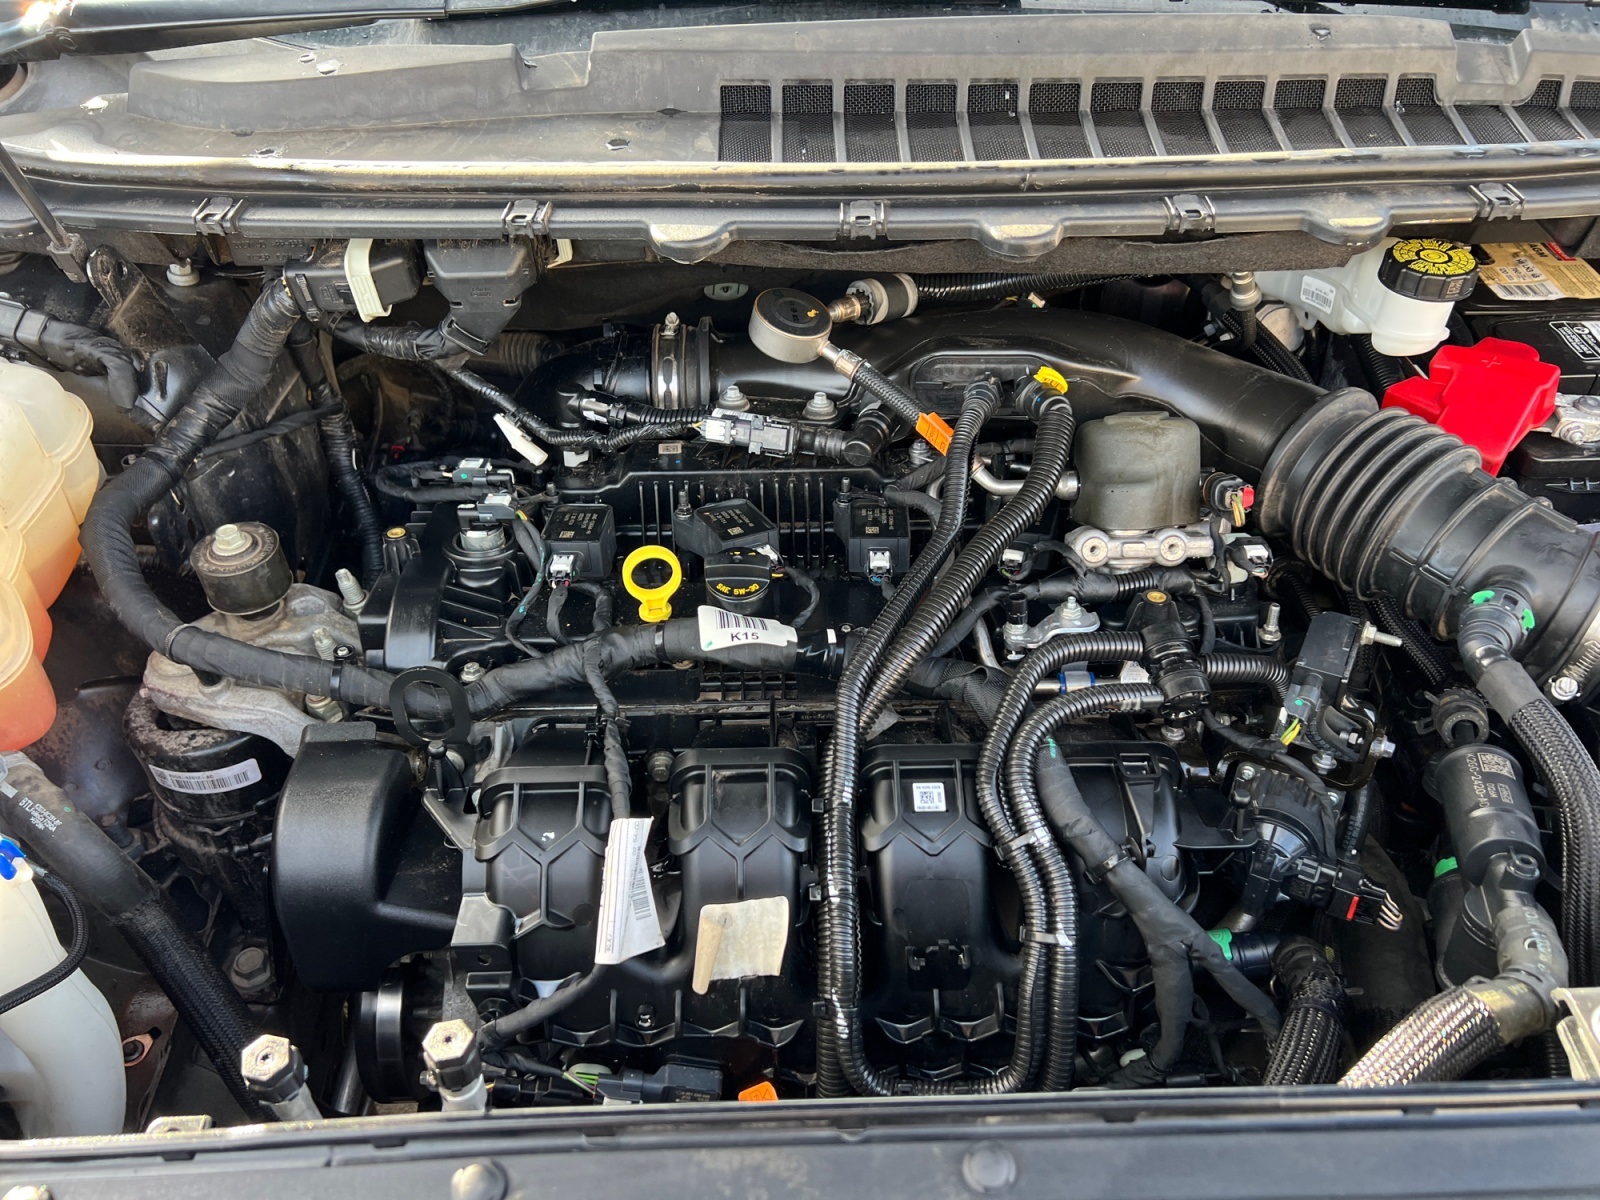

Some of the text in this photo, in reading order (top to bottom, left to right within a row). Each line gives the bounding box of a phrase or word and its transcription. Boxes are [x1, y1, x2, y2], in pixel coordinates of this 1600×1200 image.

[716, 583, 760, 595] SAE 5W-30
[730, 632, 760, 642] K15
